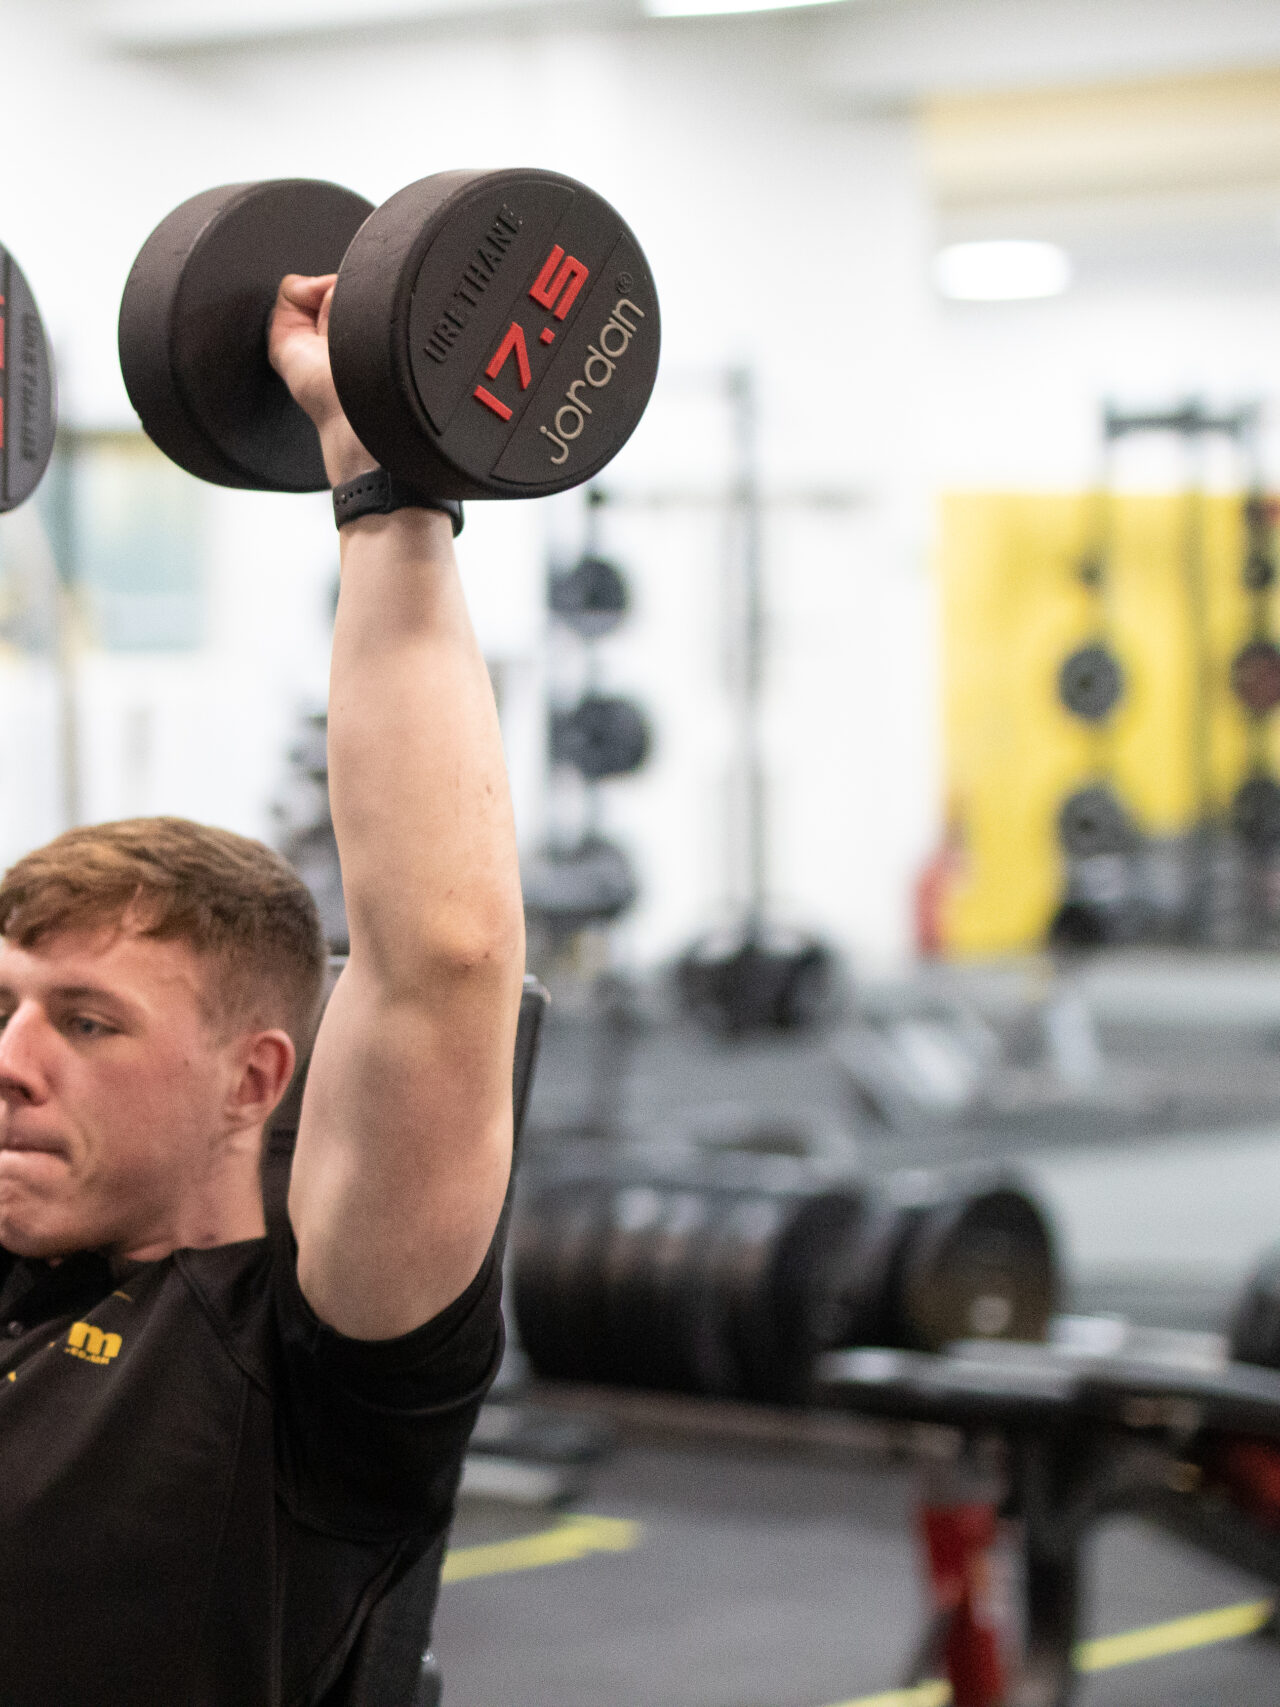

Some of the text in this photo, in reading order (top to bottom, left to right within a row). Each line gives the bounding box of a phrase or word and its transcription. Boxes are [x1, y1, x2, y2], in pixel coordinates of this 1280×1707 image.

[423, 203, 522, 363] URETHANE
[473, 244, 590, 421] 17.5
[540, 298, 646, 465] jordan
